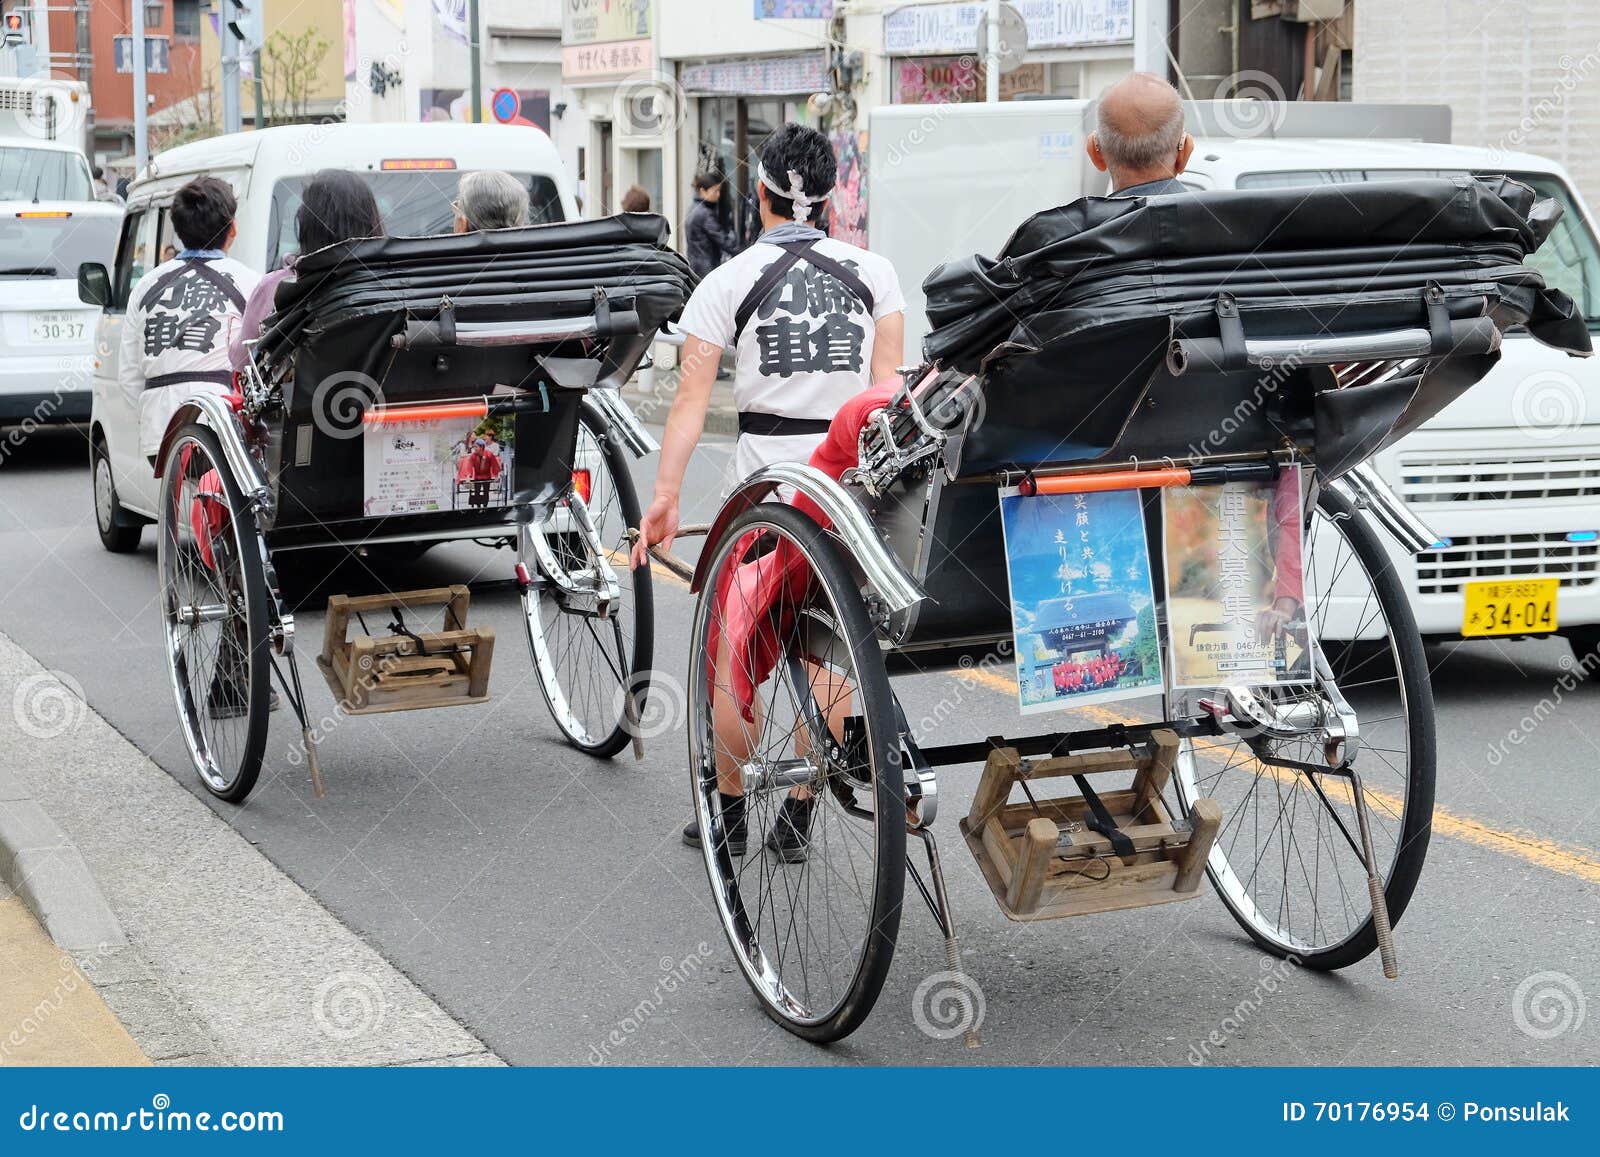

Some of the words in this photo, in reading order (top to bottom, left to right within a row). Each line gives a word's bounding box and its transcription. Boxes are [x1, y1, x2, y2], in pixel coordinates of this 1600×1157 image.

[915, 9, 940, 43] 100
[1056, 0, 1084, 35] 100
[41, 323, 85, 339] 30-37
